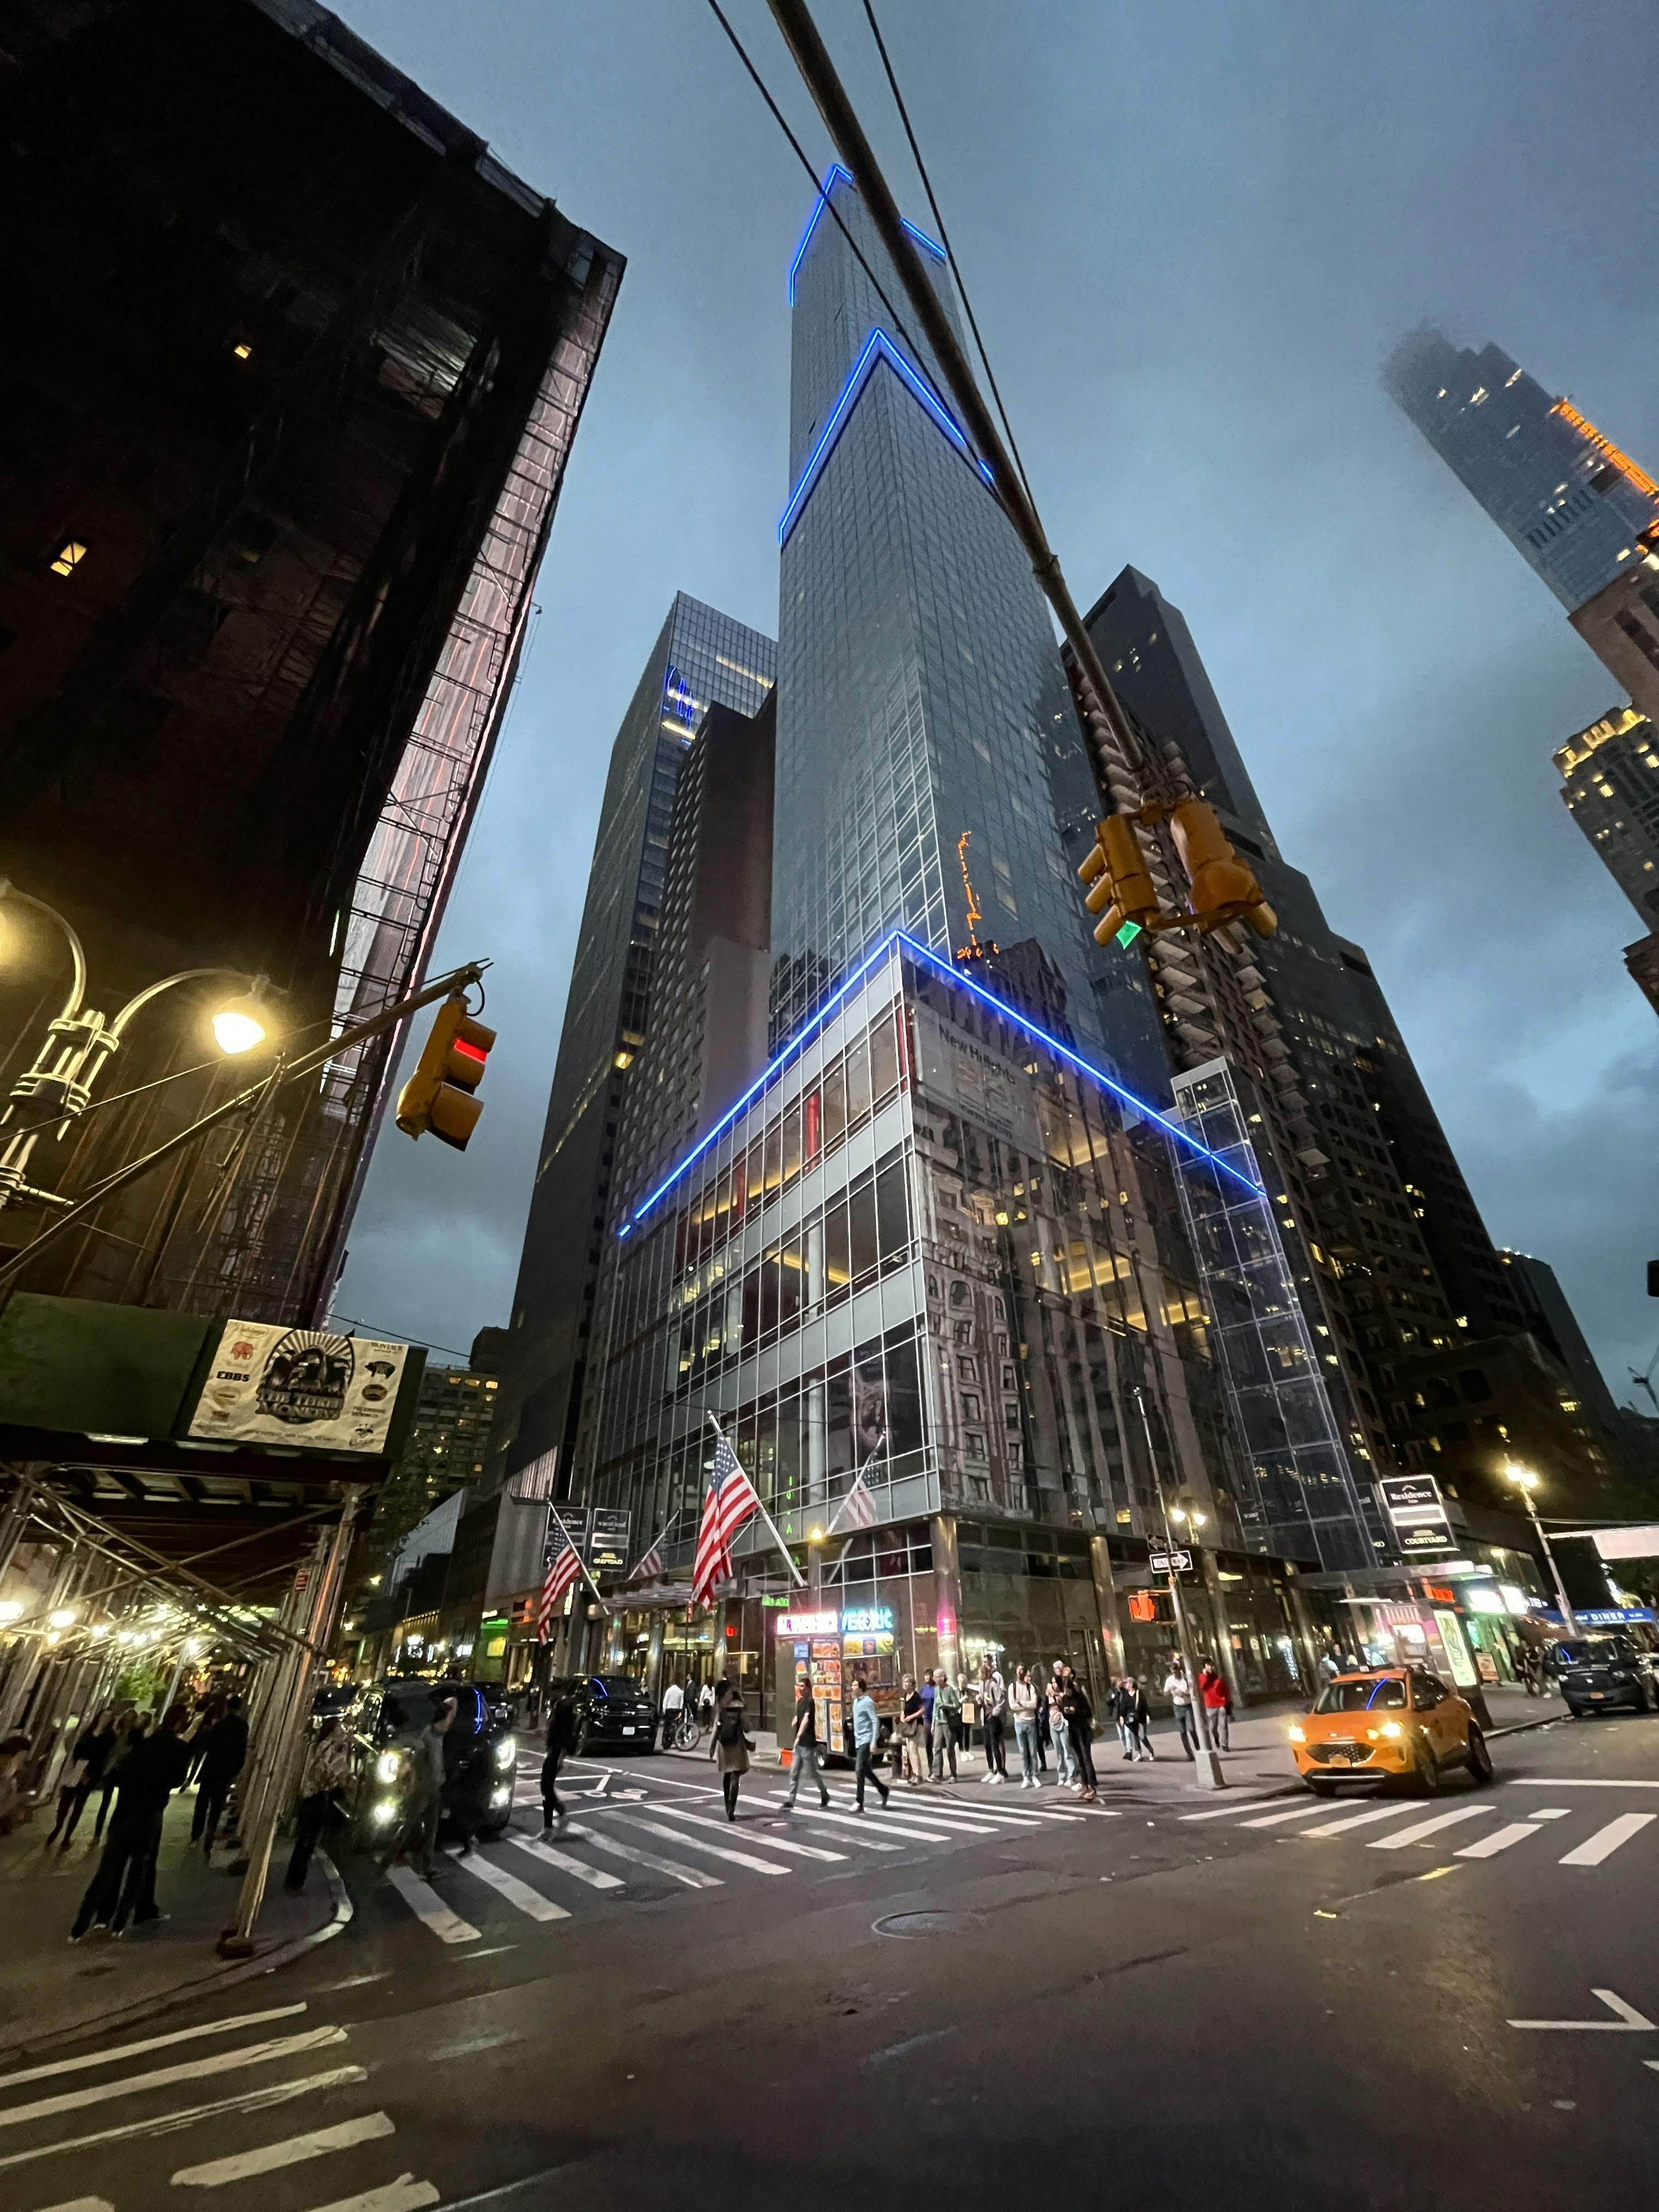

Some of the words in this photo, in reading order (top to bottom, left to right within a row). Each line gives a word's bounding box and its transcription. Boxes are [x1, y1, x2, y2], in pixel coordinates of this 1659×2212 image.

[216, 1370, 250, 1382] EBBS
[1390, 1490, 1432, 1501] Residence
[1404, 1536, 1448, 1545] COURTYARD
[1590, 1611, 1626, 1621] DINER
